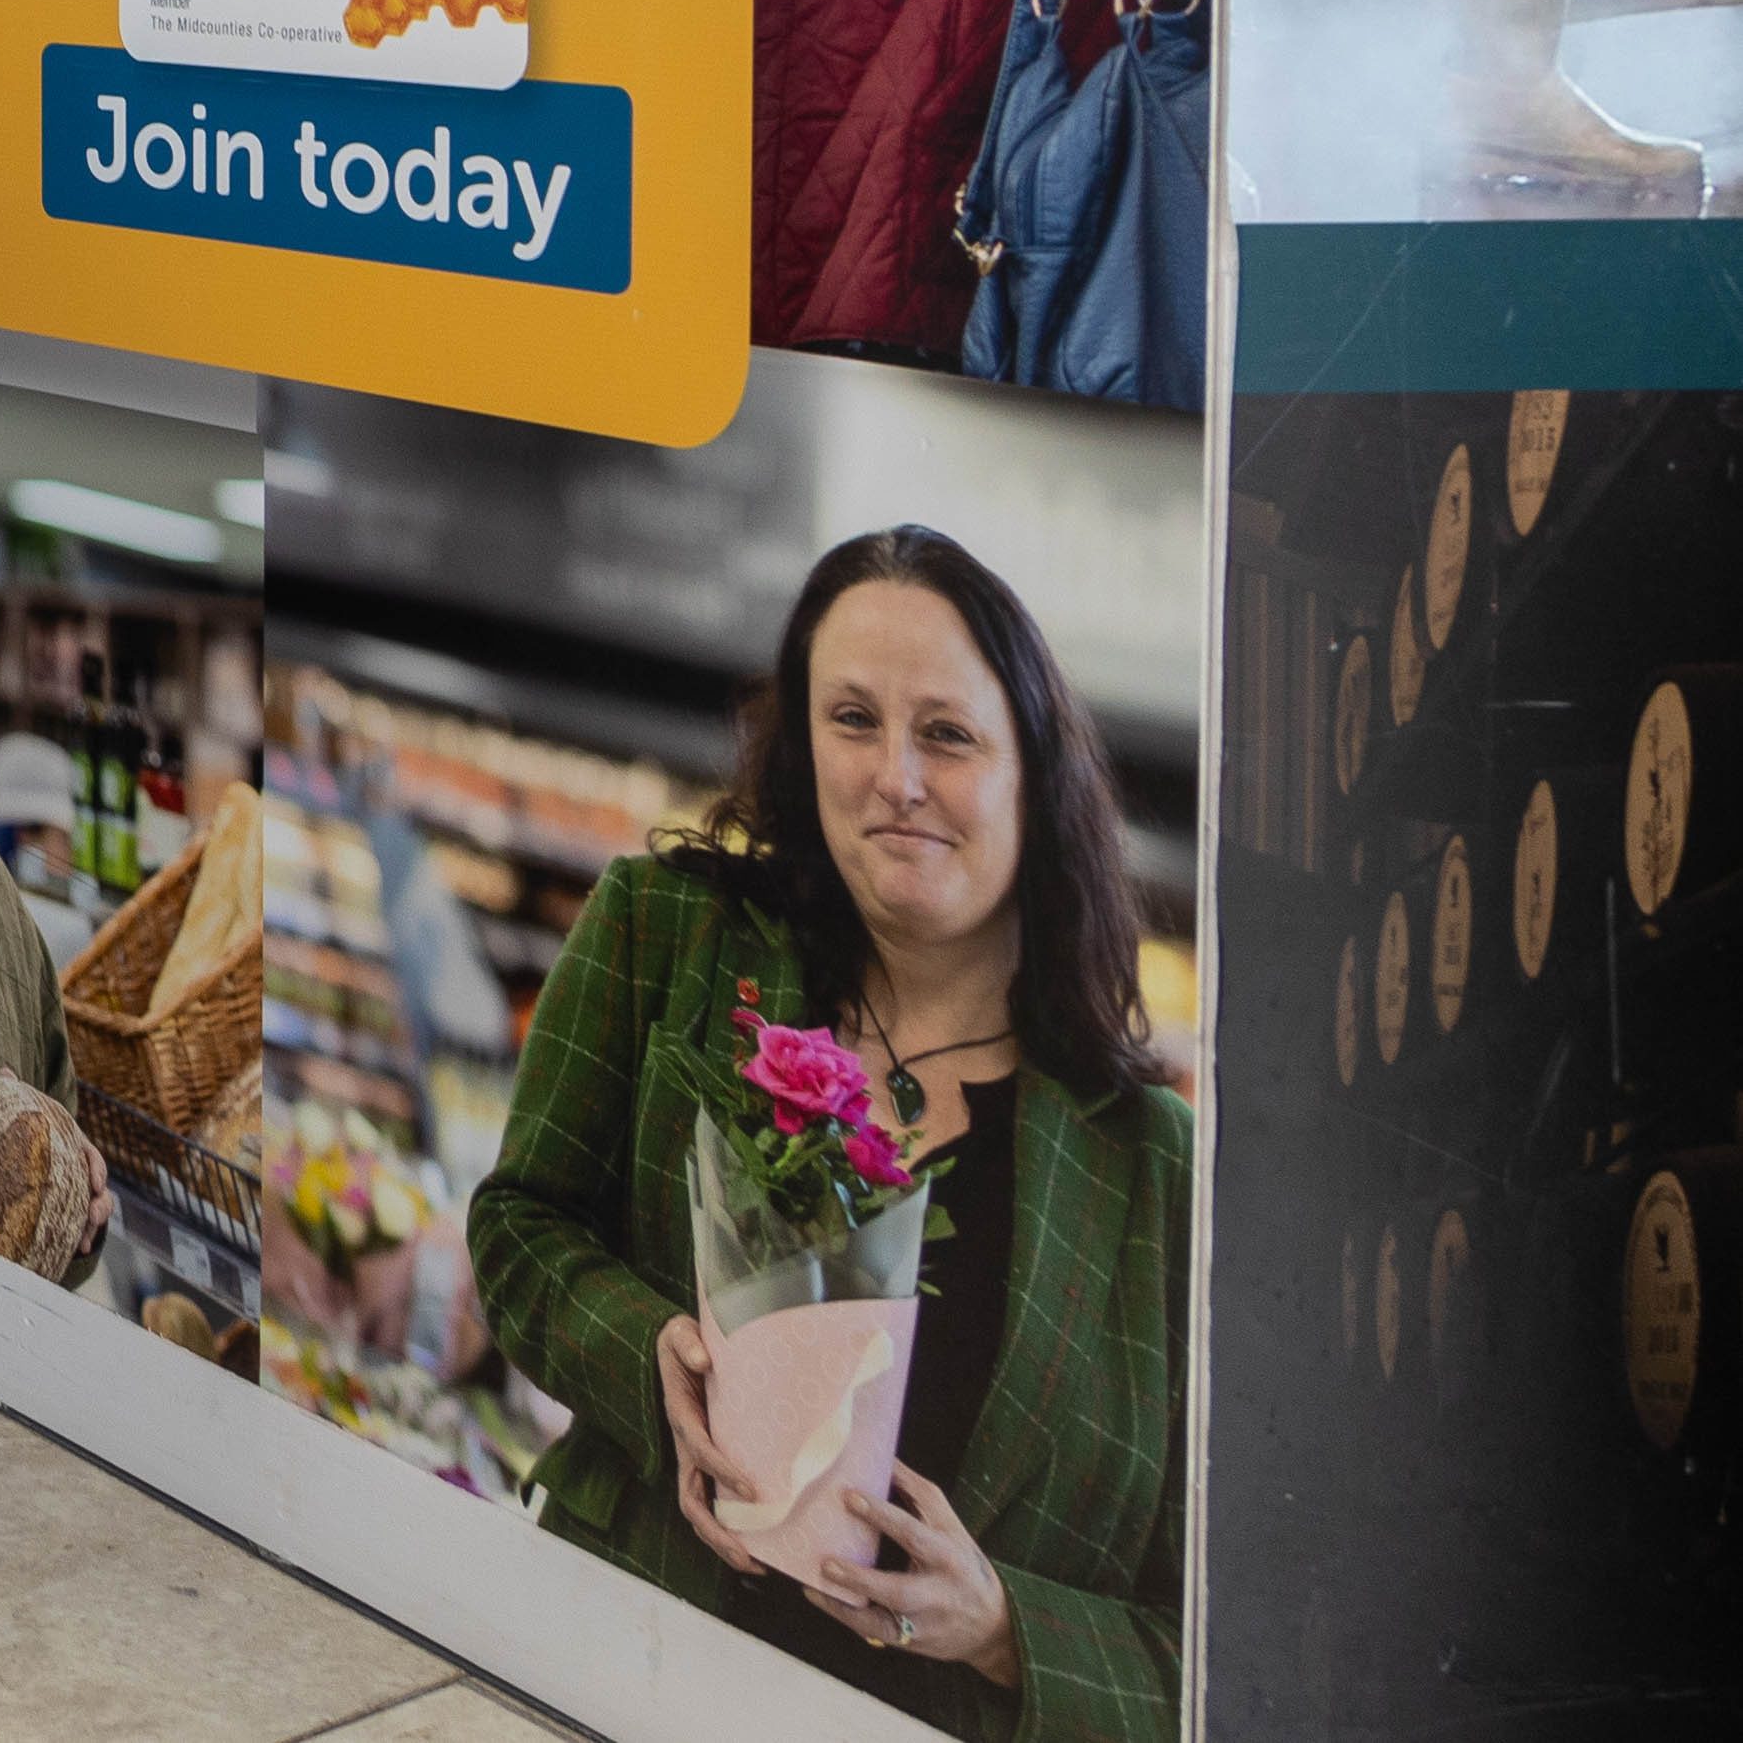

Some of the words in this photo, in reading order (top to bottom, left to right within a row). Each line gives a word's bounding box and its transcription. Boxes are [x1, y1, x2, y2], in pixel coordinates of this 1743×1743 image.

[150, 15, 172, 32] The
[177, 18, 253, 38] Midcounties
[258, 22, 343, 43] Co-operative
[85, 94, 265, 201] Join
[293, 120, 572, 263] today
